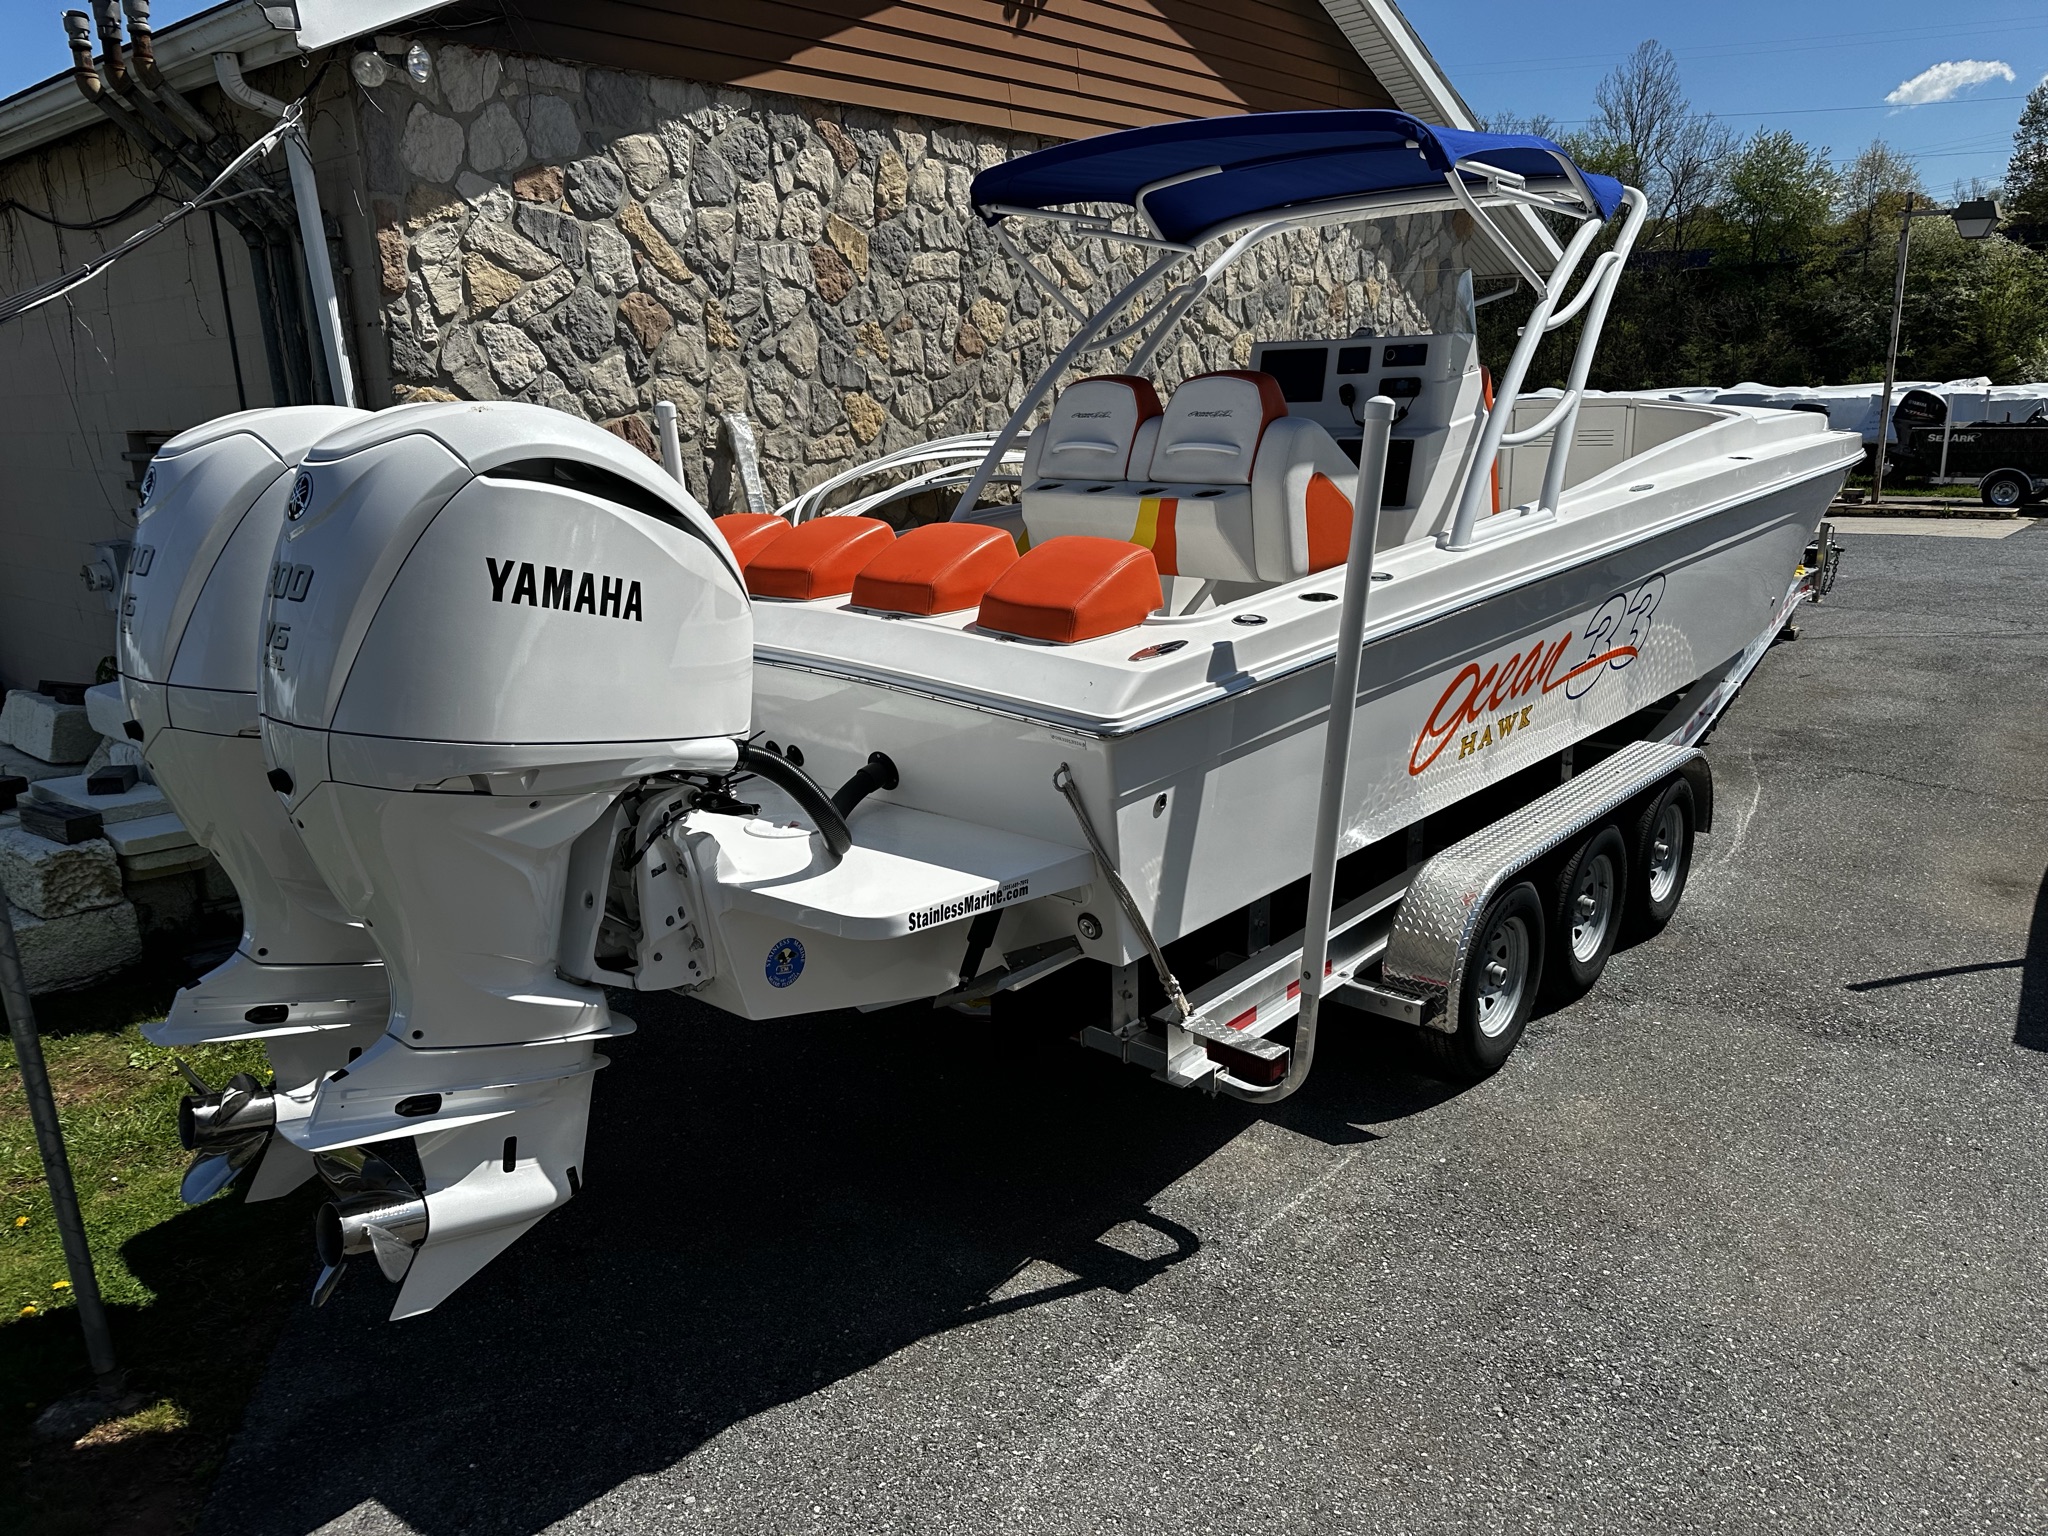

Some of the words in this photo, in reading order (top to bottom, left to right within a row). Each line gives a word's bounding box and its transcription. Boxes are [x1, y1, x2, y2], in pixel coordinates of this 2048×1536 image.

[1927, 433, 1975, 443] SEARK
[486, 557, 643, 622] YAMAHA
[1565, 572, 1666, 700] 33
[1458, 704, 1533, 760] HAWK
[908, 885, 1029, 932] StainlessMarine.com
